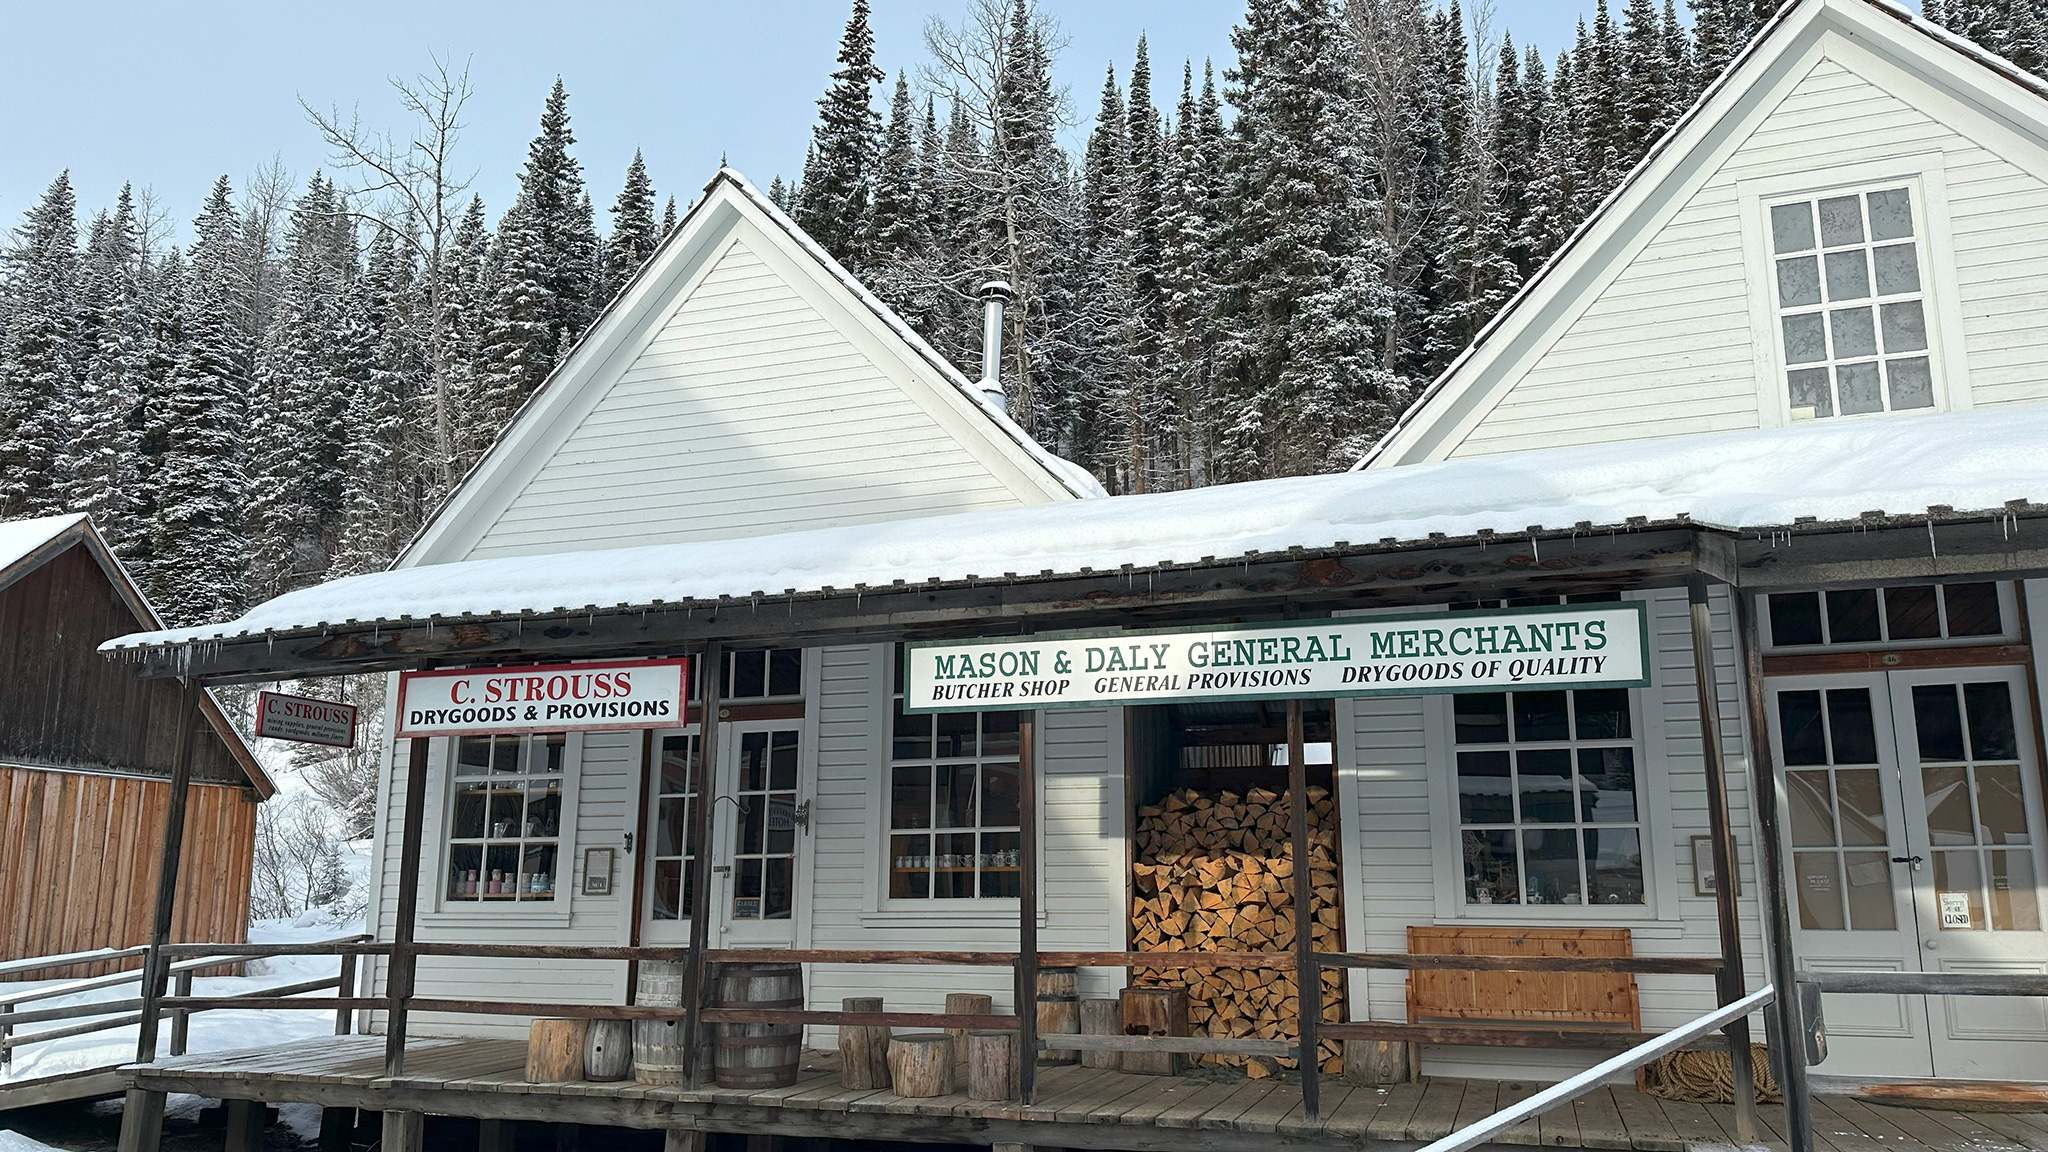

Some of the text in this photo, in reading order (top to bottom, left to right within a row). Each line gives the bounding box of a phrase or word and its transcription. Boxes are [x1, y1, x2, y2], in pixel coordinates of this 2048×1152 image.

[934, 619, 1608, 680] MASON & DALY GENERAL MERCHANTS
[450, 672, 632, 704] C. STROUSS
[932, 655, 1608, 701] BUTCHER SHOP GENERAL PROVISIONS DRYGOODS OF QUALITY
[267, 717, 284, 726] mining
[306, 723, 324, 731] general
[268, 699, 349, 725] C. STROUSS
[410, 700, 670, 726] DRYGOODS & PROVISIONS
[1944, 914, 1969, 924] CLOSED
